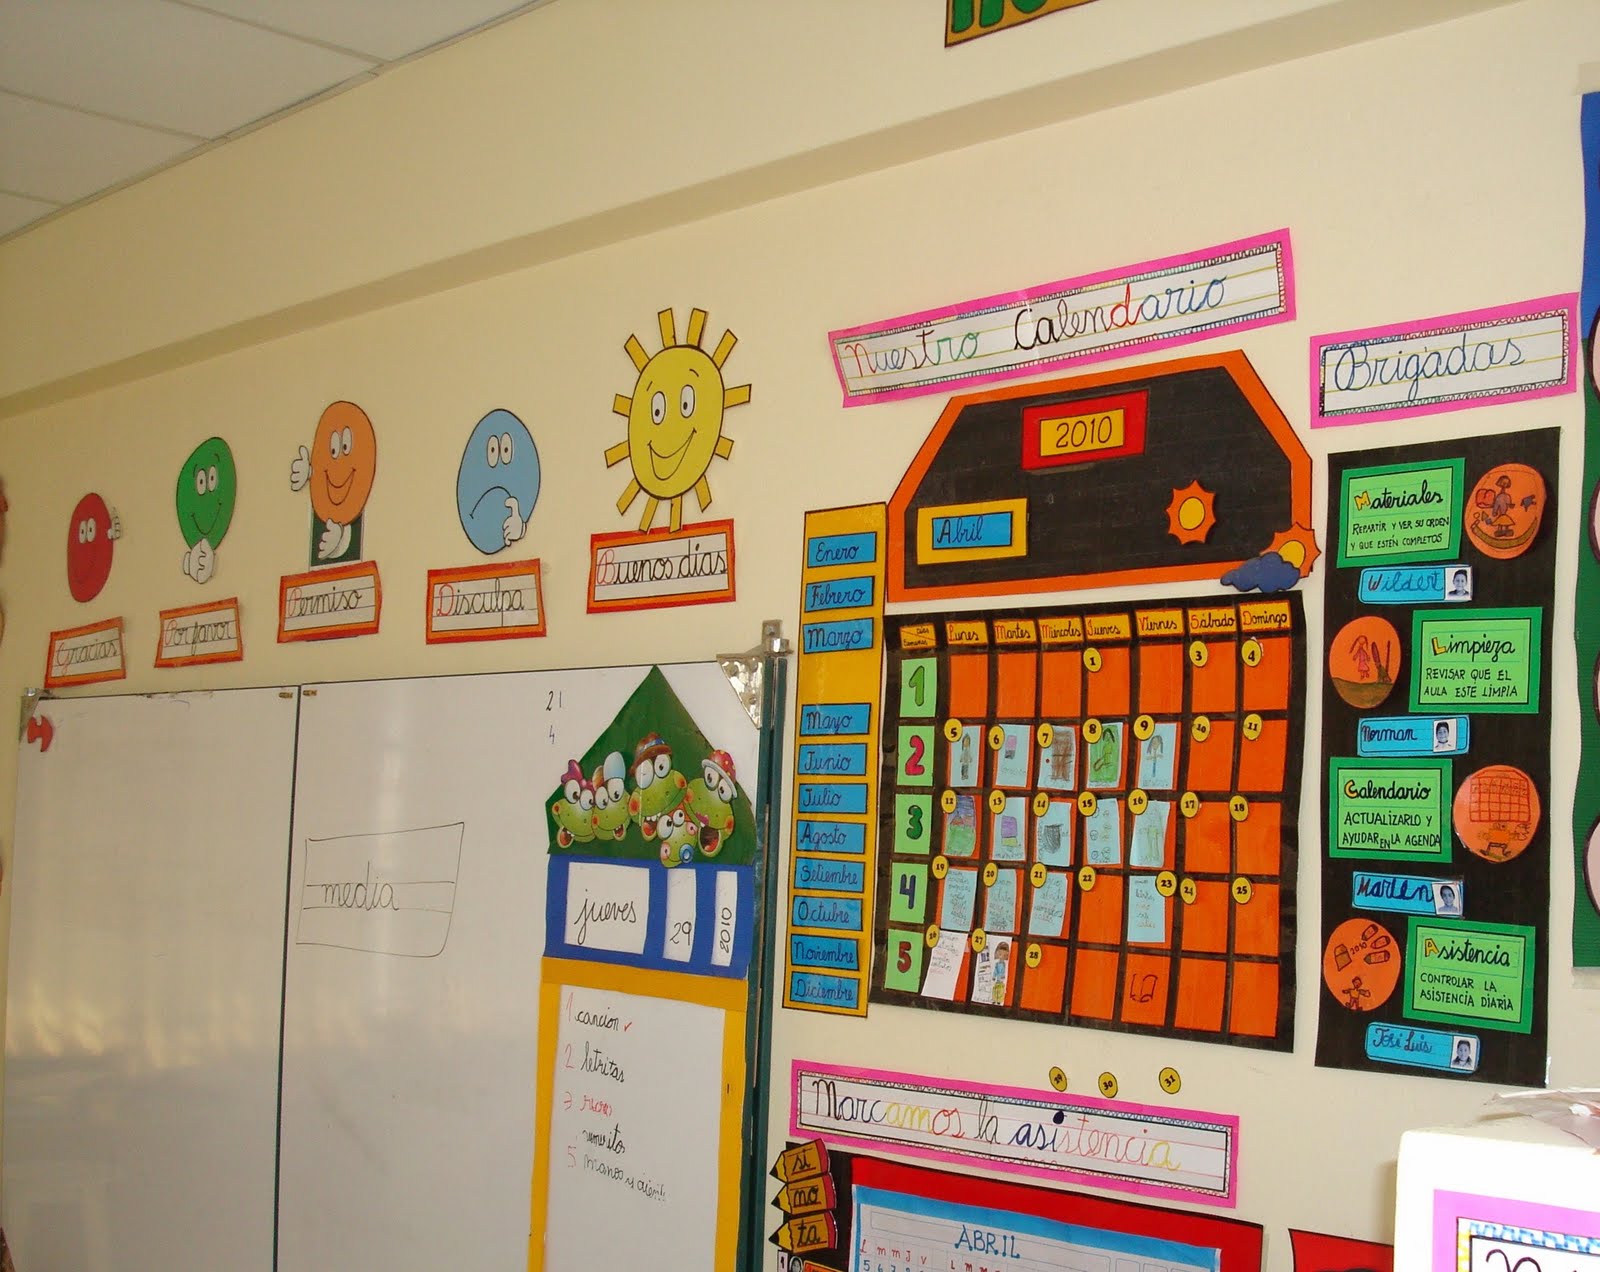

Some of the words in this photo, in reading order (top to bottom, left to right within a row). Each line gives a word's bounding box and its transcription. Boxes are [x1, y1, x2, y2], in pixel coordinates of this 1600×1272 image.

[845, 330, 980, 377] Nuestro
[1014, 275, 1228, 351] Calendario
[1335, 333, 1525, 401] Brigadas
[1055, 415, 1113, 449] 2010
[1354, 479, 1443, 512] Materiales
[936, 515, 983, 543] Abril
[1399, 520, 1413, 530] VER
[1415, 518, 1425, 527] SU
[1426, 517, 1450, 528] ORDEN
[816, 541, 859, 562] Enero
[1359, 539, 1373, 550] QUE
[1402, 534, 1443, 546] COMPLETOS
[597, 549, 673, 585] Buenos
[288, 588, 362, 616] Permiso
[436, 577, 524, 627] Disculpa
[811, 583, 865, 608] Febrero
[949, 624, 979, 641] Lunes
[995, 622, 1031, 639] Martes
[1087, 619, 1120, 636] Jueves
[1139, 617, 1178, 631] Viernes
[1243, 610, 1287, 627] Domingo
[808, 627, 863, 650] Marzo
[1432, 633, 1516, 662] Limpieza
[56, 638, 118, 676] Gracias
[1195, 651, 1203, 661] 3
[1247, 650, 1256, 662] 4
[909, 665, 925, 707] 1
[1426, 668, 1465, 680] REVISAR
[1471, 668, 1491, 681] QUE
[1497, 670, 1512, 680] EL
[1424, 685, 1448, 696] AULA
[807, 712, 853, 734] Mayo
[951, 727, 958, 737] 5
[994, 734, 1000, 744] 6
[1042, 732, 1049, 743] 7
[1089, 724, 1097, 734] 8
[1140, 721, 1149, 731] 9
[1197, 723, 1206, 733] 10
[1248, 721, 1258, 731] 11
[1361, 726, 1418, 741] Norman
[804, 751, 851, 771] Junio
[905, 735, 925, 776] 2
[802, 788, 842, 807] Julio
[1344, 780, 1432, 801] Calendario
[993, 797, 1003, 805] 13
[1037, 800, 1046, 808] 14
[1082, 799, 1092, 807] 15
[1133, 797, 1143, 805] 16
[1234, 804, 1244, 812] 18
[907, 805, 923, 840] 3
[800, 823, 847, 850] Agosto
[1342, 832, 1379, 846] AYUDAR
[1379, 839, 1391, 849] EN
[1391, 834, 1401, 845] LA
[1405, 834, 1440, 847] AGENDA
[800, 862, 858, 885] Setiembre
[936, 863, 944, 871] 19
[986, 870, 995, 878] 20
[1034, 871, 1043, 879] 21
[1082, 874, 1092, 882] 22
[1161, 879, 1172, 887] 23
[1236, 886, 1247, 894] 25
[321, 860, 399, 911] media
[899, 873, 916, 909] 4
[574, 888, 637, 945] jueves
[670, 920, 692, 946] 29
[720, 907, 732, 954] 2010
[798, 901, 849, 923] Octubre
[794, 941, 854, 964] Noviembre
[897, 941, 912, 973] 5
[1029, 951, 1039, 959] 28
[1424, 938, 1511, 967] Asistencia
[795, 978, 853, 1001] Diciembre
[1420, 972, 1474, 989] CONTROLAR
[1484, 980, 1497, 992] LA
[1420, 986, 1475, 1007] ASISTENCIA
[1103, 1080, 1113, 1090] 30
[1165, 1075, 1176, 1087] 31
[812, 1079, 966, 1138] Marcamos
[975, 1099, 1001, 1145] la
[1008, 1110, 1182, 1171] asistencia
[955, 1224, 1021, 1258] ABRIL
[863, 1260, 871, 1271] 5
